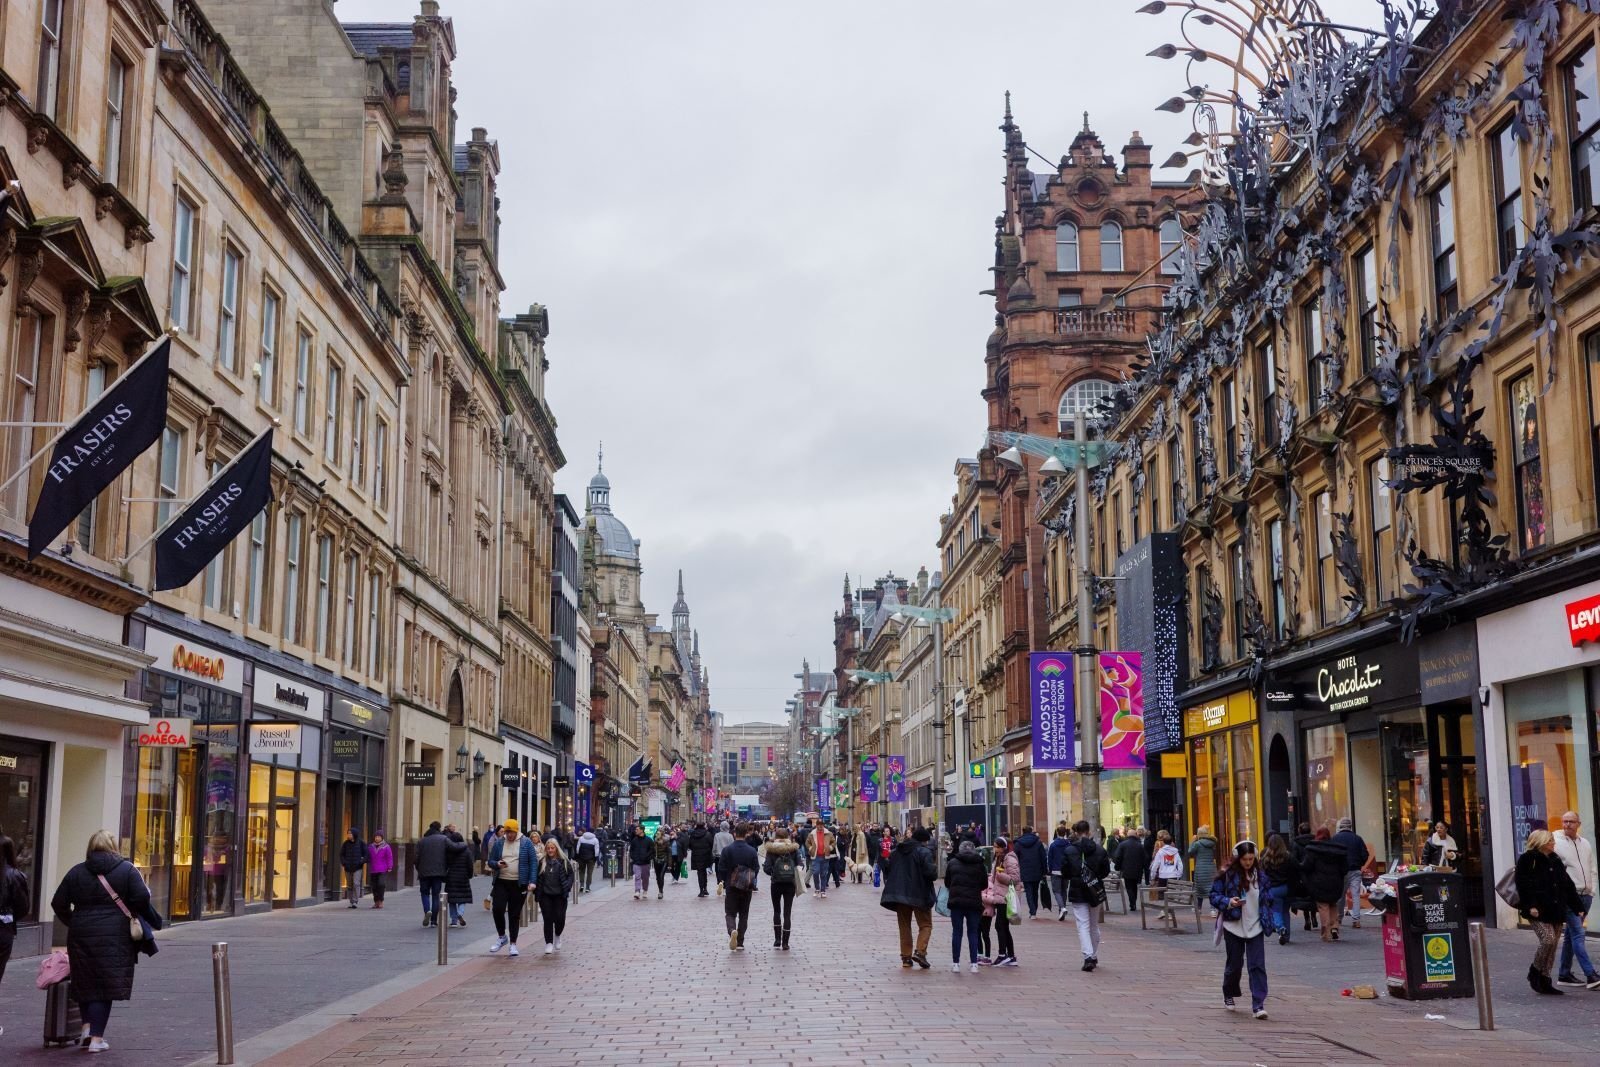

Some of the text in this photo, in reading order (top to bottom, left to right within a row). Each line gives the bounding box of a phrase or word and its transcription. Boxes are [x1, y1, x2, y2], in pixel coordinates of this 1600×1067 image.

[49, 403, 132, 484] FRASERS
[90, 456, 102, 467] EST
[1405, 457, 1481, 466] PRINCES SQUARE
[174, 483, 242, 549] FRASERS
[1337, 655, 1357, 671] HOTEL
[1039, 680, 1051, 760] GLASGOW 24
[1057, 680, 1066, 760] WORLD ATHLETICS
[139, 734, 187, 745] OMEGA
[258, 729, 291, 739] Russell
[1514, 804, 1539, 820] DENIM
[1516, 822, 1532, 838] FOR
